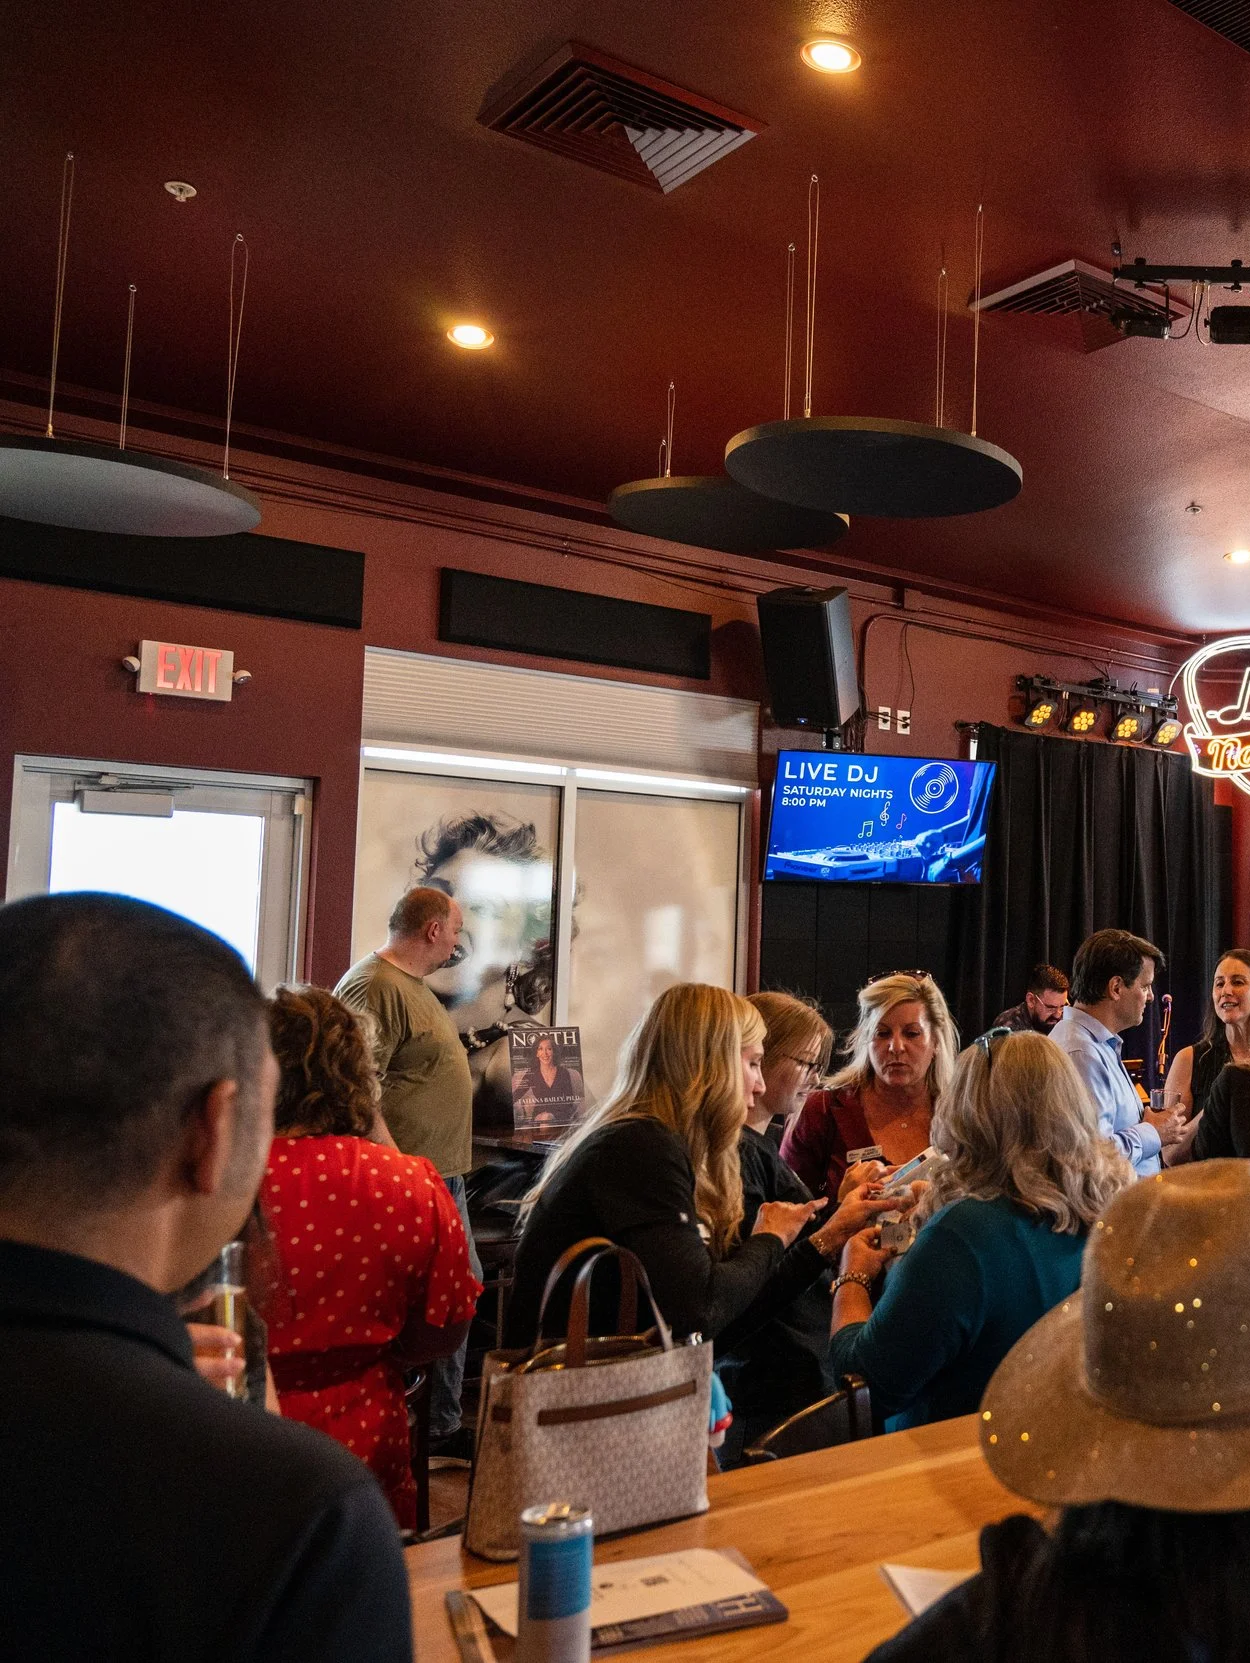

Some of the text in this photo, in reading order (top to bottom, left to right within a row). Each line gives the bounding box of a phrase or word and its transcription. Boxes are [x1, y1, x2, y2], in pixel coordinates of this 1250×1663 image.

[156, 644, 222, 693] EXIT
[784, 761, 879, 783] LIVE DJ
[783, 785, 894, 799] SATURDAY NIGHTS
[781, 797, 827, 807] 8:00 PM
